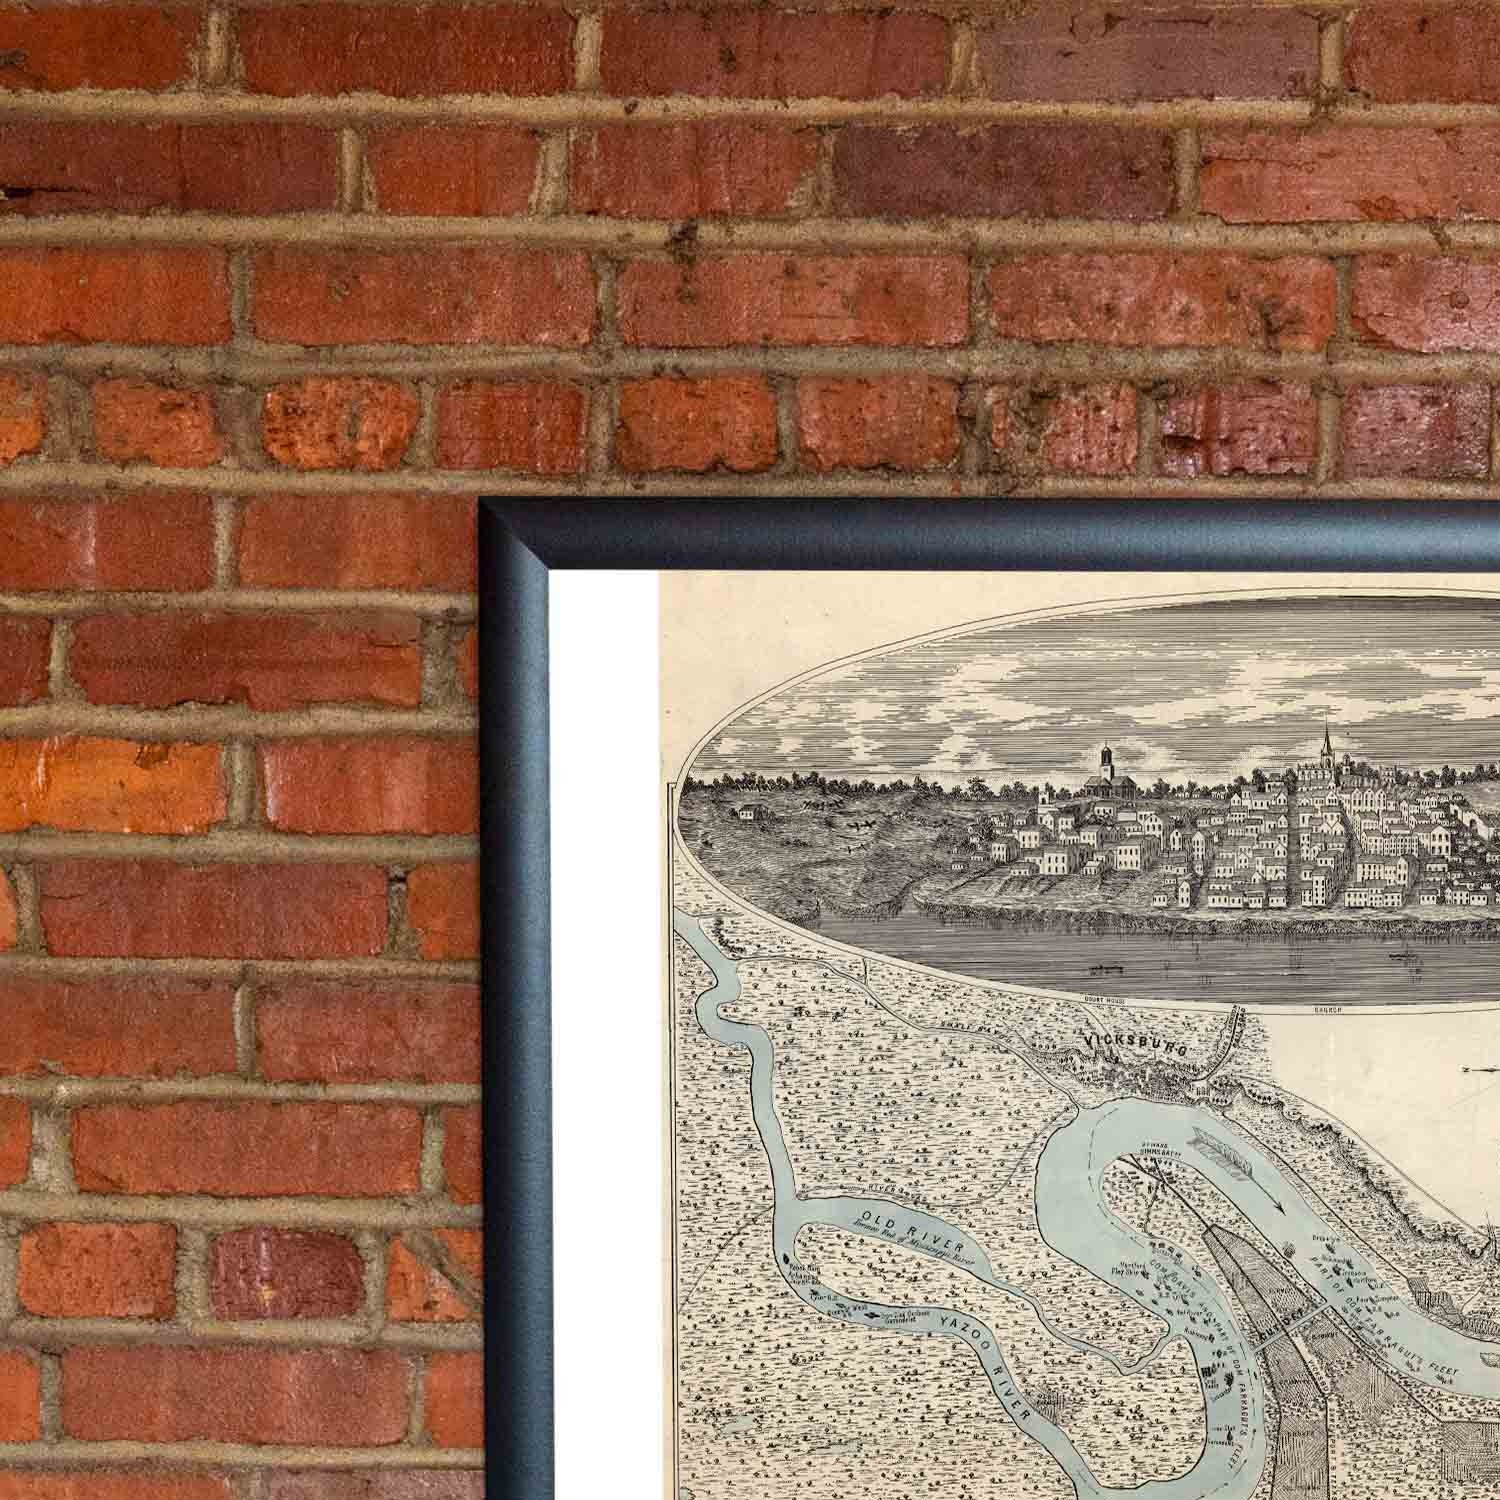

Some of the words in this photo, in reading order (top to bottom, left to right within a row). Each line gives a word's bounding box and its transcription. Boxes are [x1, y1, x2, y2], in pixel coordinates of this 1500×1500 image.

[1084, 1033, 1188, 1057] VICKSBURG
[862, 1210, 895, 1228] OLD
[907, 1226, 964, 1252] RIVER
[940, 1317, 990, 1350] YAZOO
[993, 1366, 1031, 1420] RIVER
[1428, 1362, 1459, 1376] FLEET
